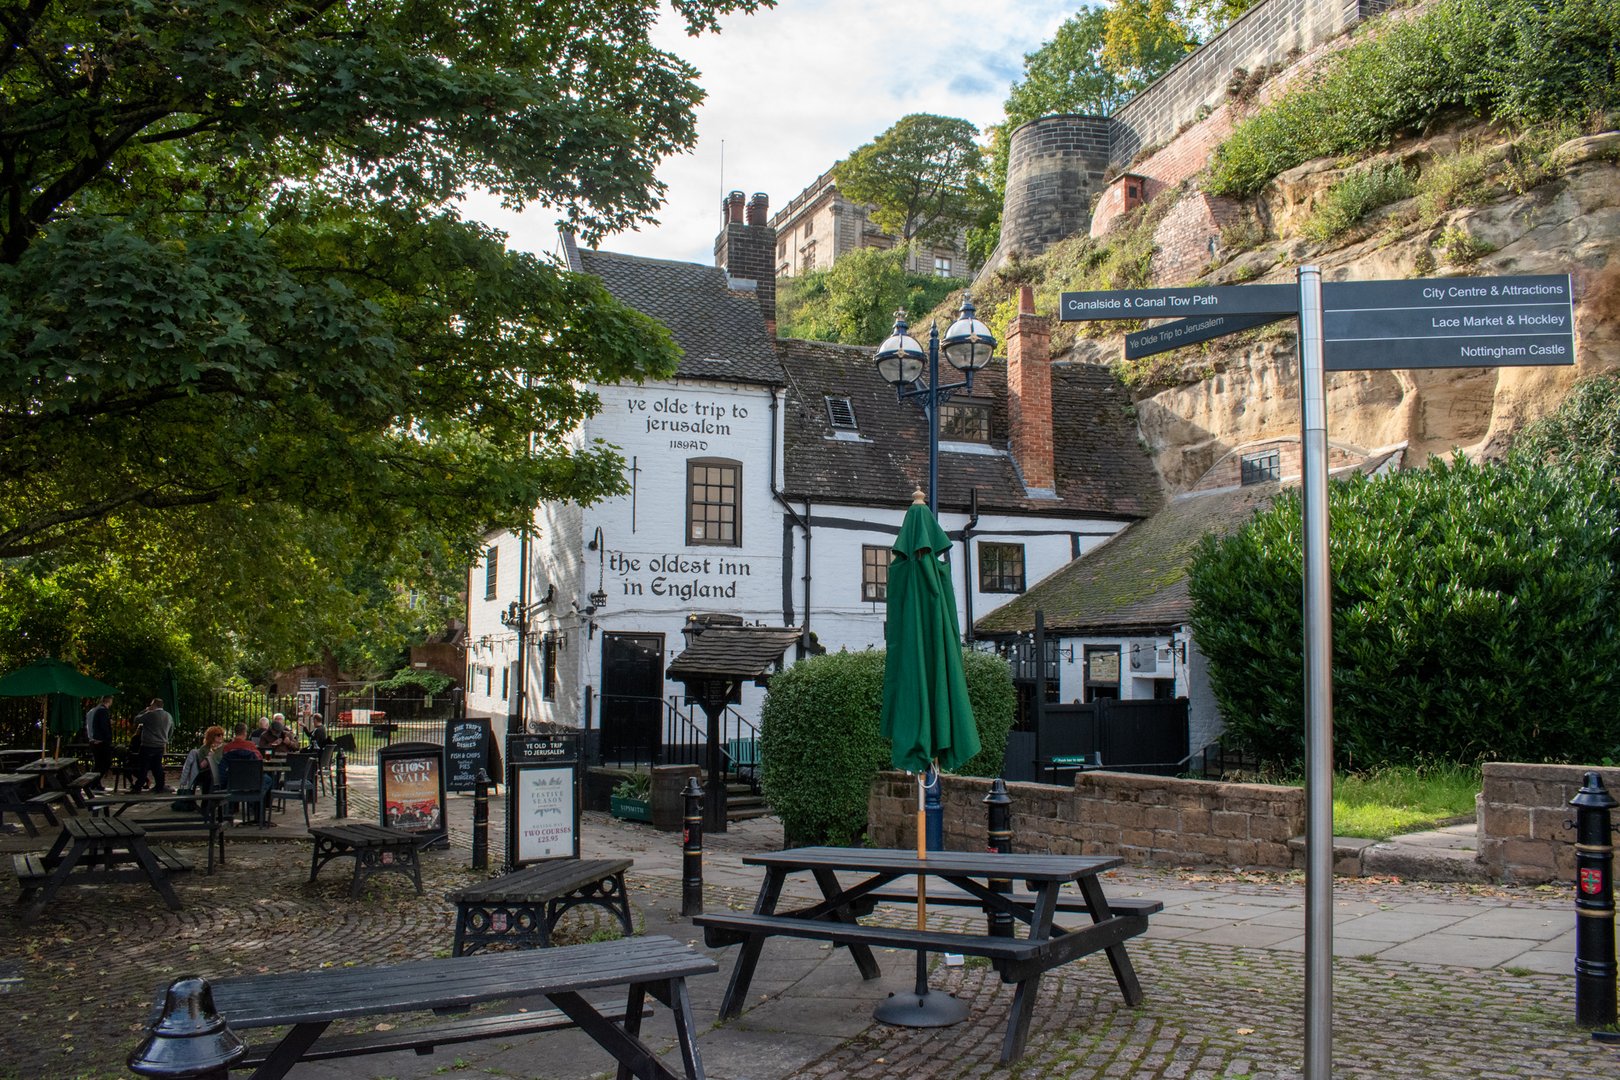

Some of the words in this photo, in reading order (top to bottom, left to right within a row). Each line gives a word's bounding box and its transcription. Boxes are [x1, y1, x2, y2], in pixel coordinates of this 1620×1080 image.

[1422, 287, 1445, 300] City
[1448, 286, 1487, 298] Centre
[1490, 286, 1499, 296] &
[1502, 284, 1564, 296] Attractions
[1068, 299, 1121, 310] Canalside
[1123, 298, 1132, 308] &
[1134, 296, 1166, 308] Canal
[1168, 296, 1191, 306] Tow
[1193, 294, 1218, 306] Path
[1432, 317, 1460, 328] Lace
[1463, 316, 1503, 327] Market
[1506, 314, 1516, 326] &
[1518, 314, 1566, 326] Hockley
[1129, 339, 1140, 350] Ye
[1140, 334, 1158, 347] Olde
[1159, 330, 1174, 342] Trip
[1174, 328, 1183, 337] to
[1183, 316, 1224, 335] Jerusalem
[1460, 346, 1526, 358] Nottingham
[1528, 344, 1566, 355] Castle
[627, 398, 647, 414] ye
[653, 397, 689, 415] olde
[694, 402, 726, 420] trip
[732, 403, 749, 419] to
[646, 416, 731, 436] jerusalem
[609, 552, 641, 576] the
[649, 554, 711, 575] oldest
[719, 557, 751, 576] inn
[623, 577, 643, 596] in
[650, 576, 737, 601] England
[533, 748, 565, 756] JERUSALEM
[391, 760, 433, 773] GHOST
[394, 772, 430, 784] WALK
[531, 790, 564, 798] FESTIVE
[532, 797, 563, 805] SEASON
[541, 826, 572, 835] COURSES
